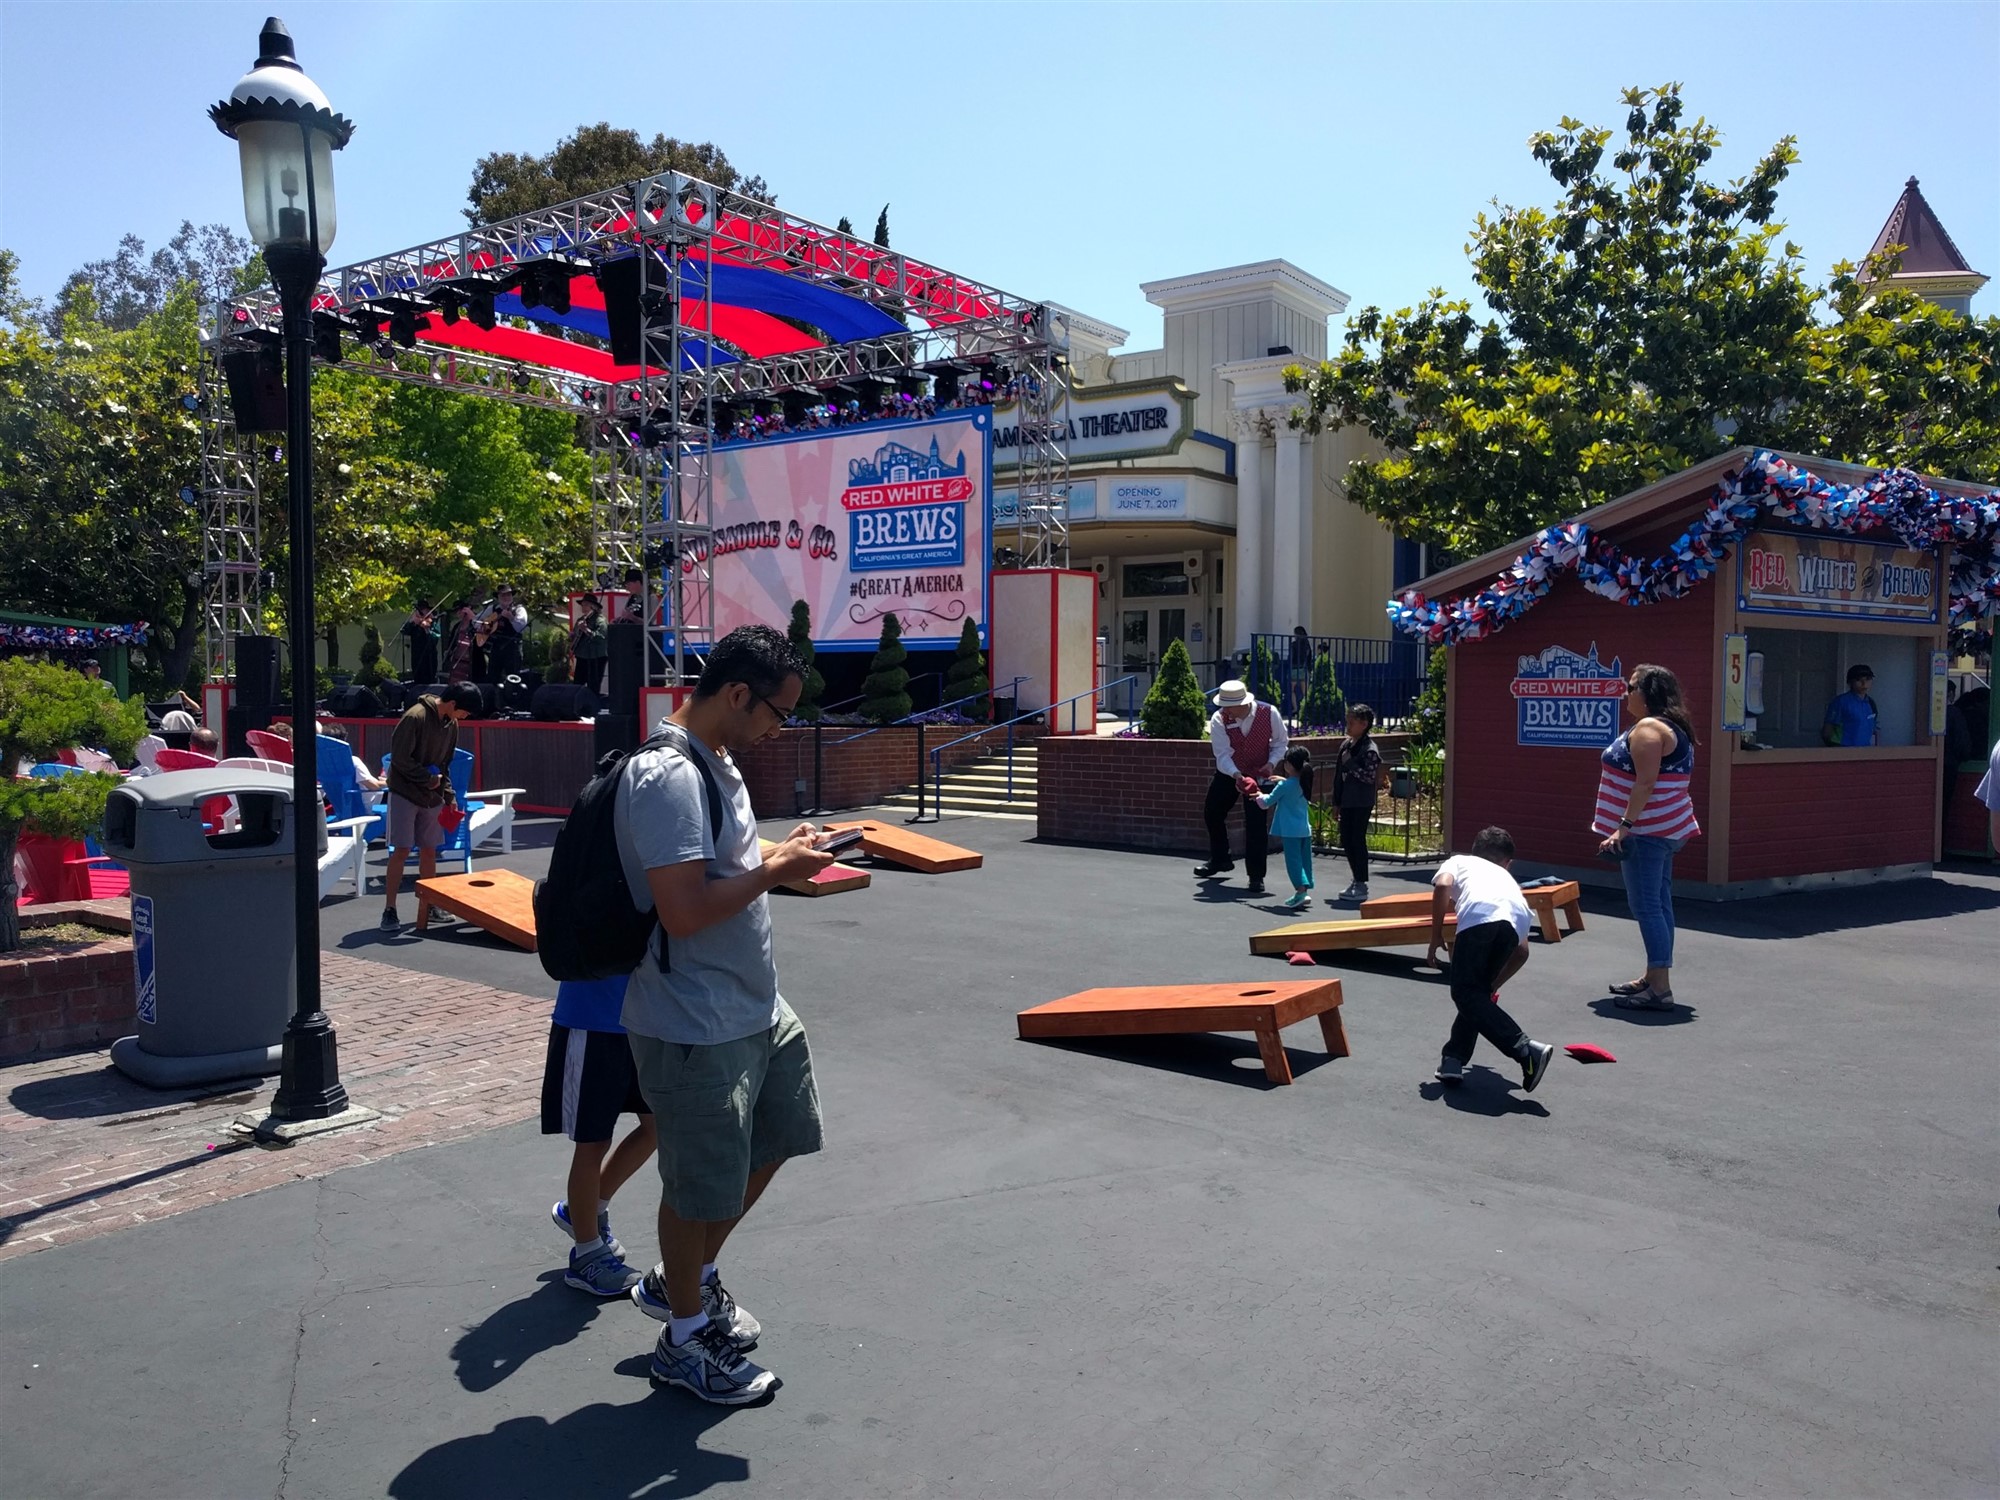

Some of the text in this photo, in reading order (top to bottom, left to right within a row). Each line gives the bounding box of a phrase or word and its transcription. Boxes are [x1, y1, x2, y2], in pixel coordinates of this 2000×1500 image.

[1079, 407, 1168, 438] THEATER
[887, 483, 944, 502] WHITE
[1117, 488, 1161, 497] OPENING
[1117, 500, 1142, 509] JUNE
[1157, 499, 1178, 509] 2017
[857, 506, 957, 546] BREWS
[786, 519, 803, 549] &
[808, 524, 838, 561] CO.
[859, 550, 953, 562] CALIFORNIA'S GREAT AMERICA
[1750, 548, 1790, 590] RED,
[1797, 554, 1857, 593] WHITE
[1881, 562, 1931, 599] BREWS
[1731, 653, 1741, 684] 5
[1551, 682, 1601, 694] WHITE
[1524, 700, 1612, 727] BREWS
